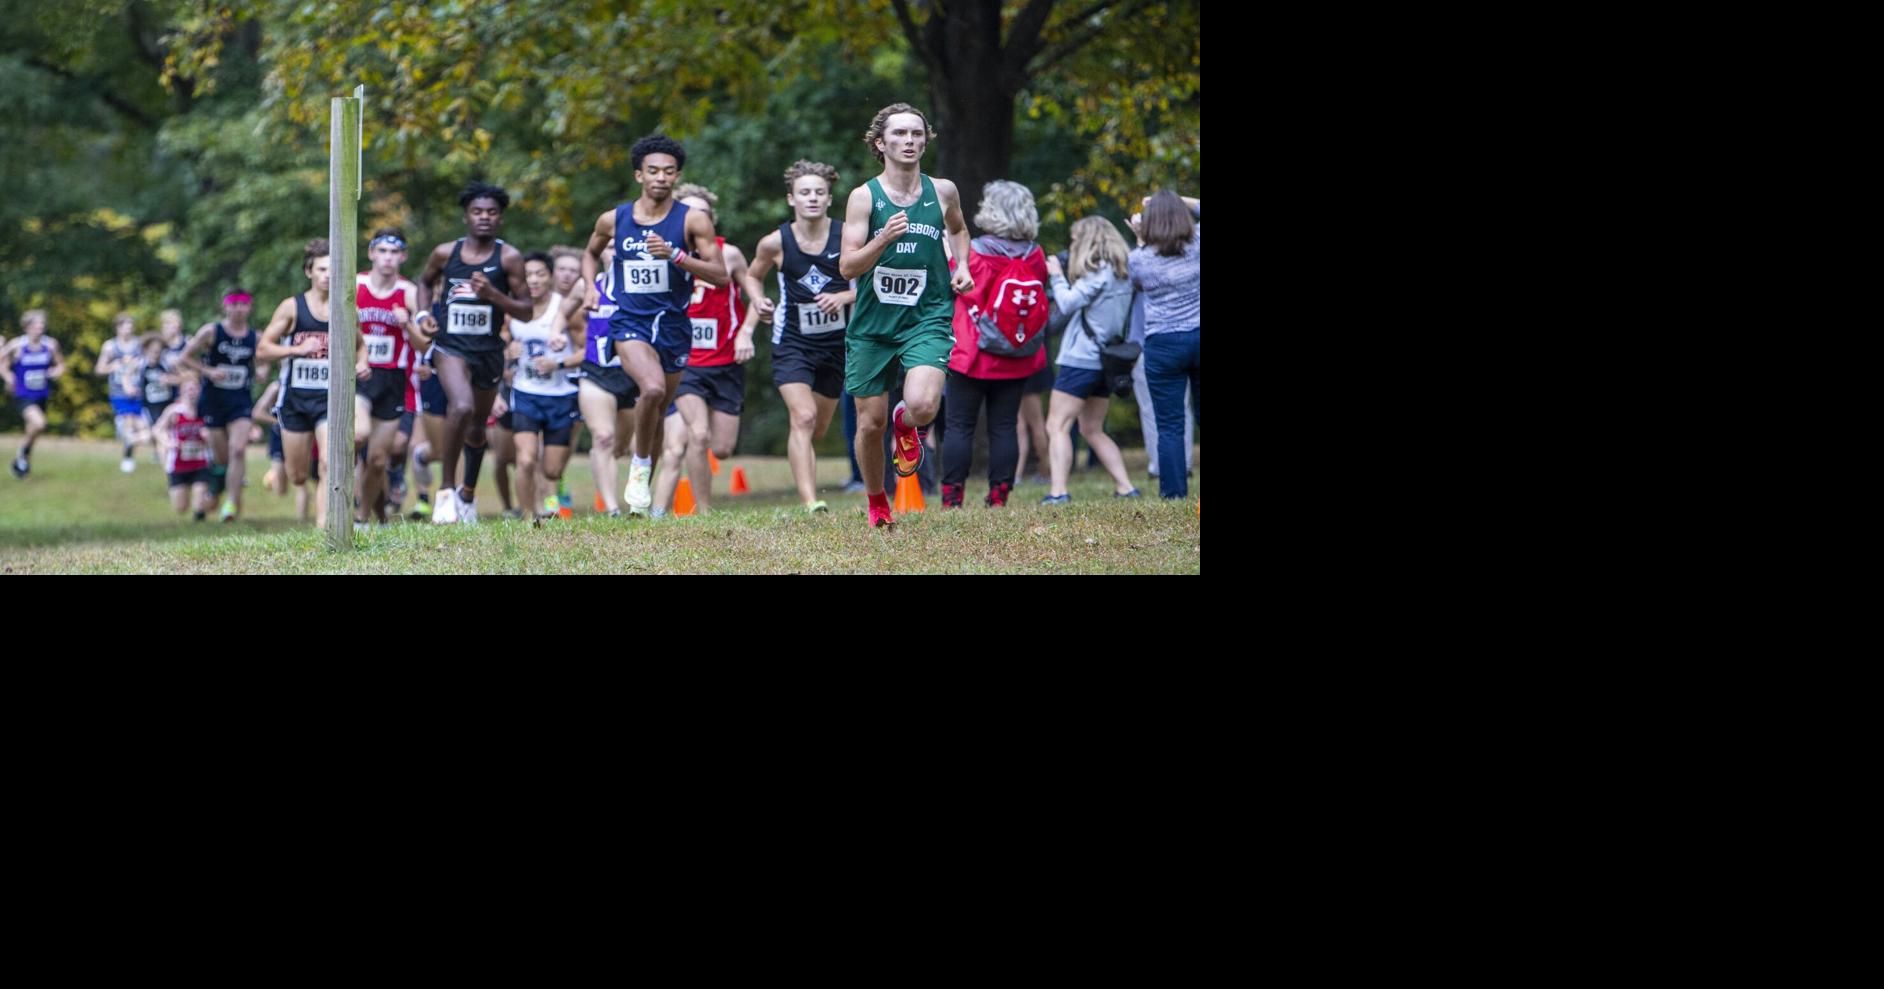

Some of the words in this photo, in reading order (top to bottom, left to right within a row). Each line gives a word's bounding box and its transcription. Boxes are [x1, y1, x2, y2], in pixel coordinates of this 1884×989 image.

[895, 242, 918, 254] DAY
[631, 268, 660, 285] 931
[810, 275, 821, 285] R
[880, 275, 920, 297] 902
[453, 312, 488, 327] 1198
[694, 326, 714, 341] 30
[296, 366, 329, 381] 1189
